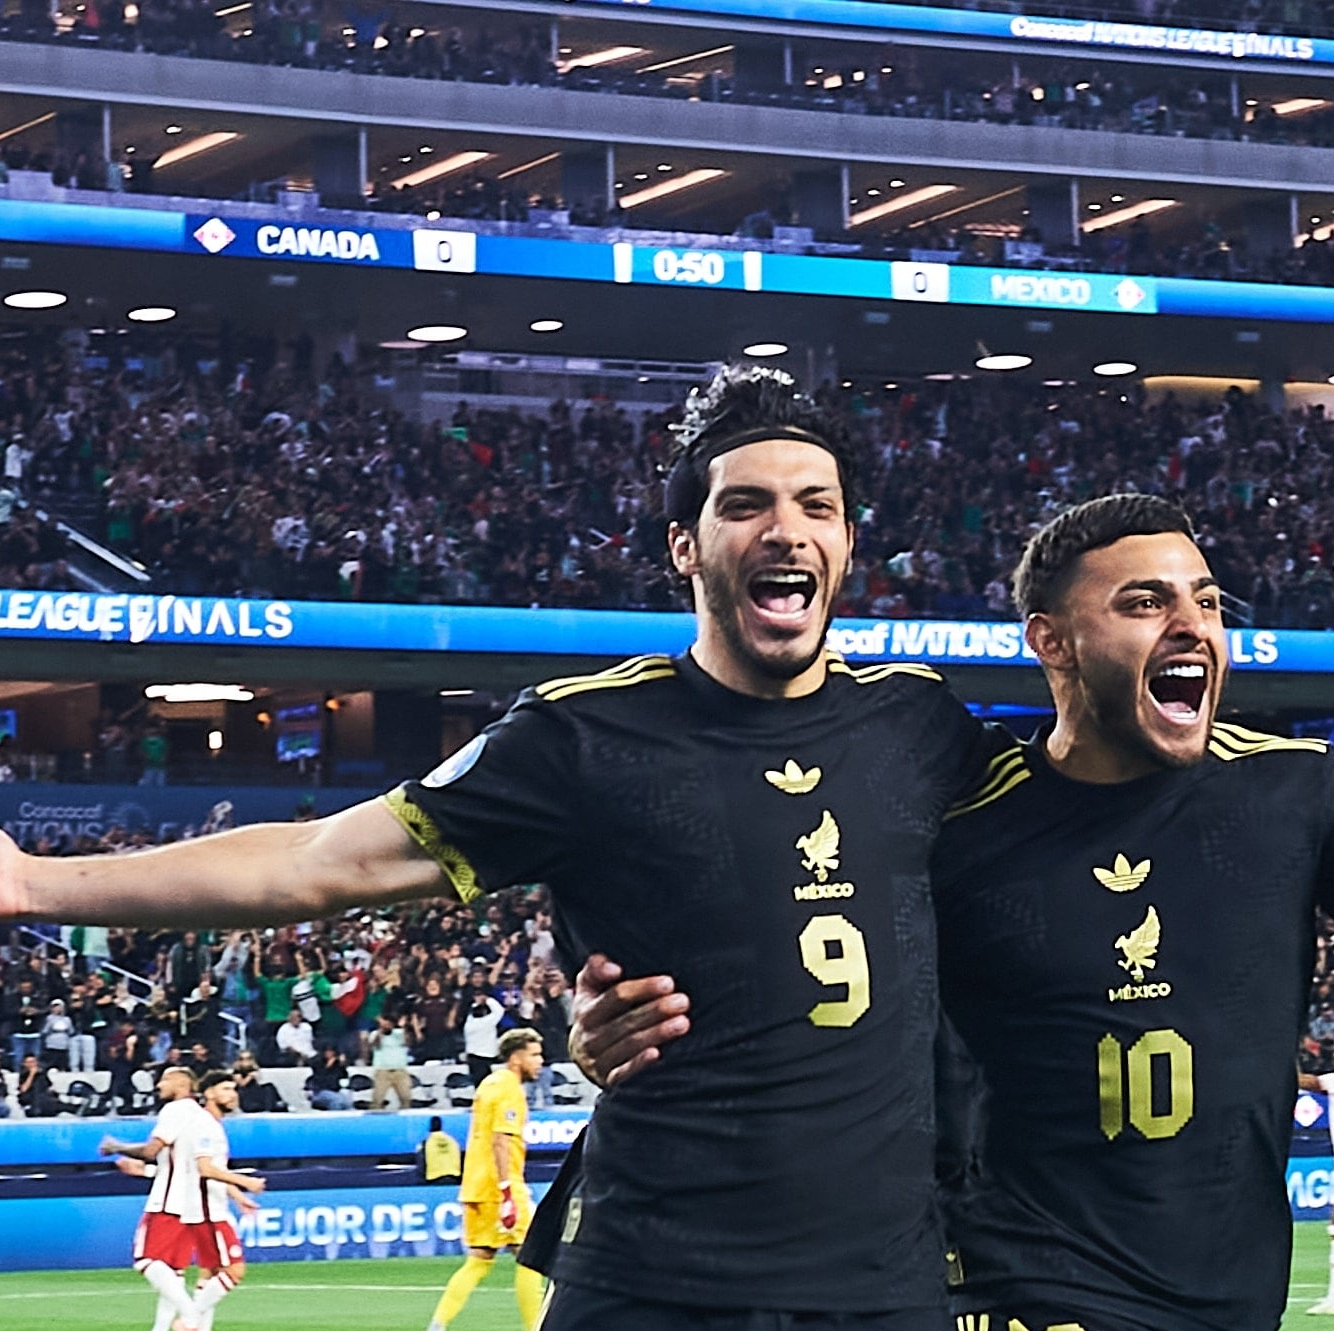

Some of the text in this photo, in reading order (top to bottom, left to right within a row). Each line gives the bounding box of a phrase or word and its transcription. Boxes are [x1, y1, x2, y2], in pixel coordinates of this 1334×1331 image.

[257, 225, 1092, 306] CANADA 0 0:50 0 MEXICO
[890, 622, 1021, 658] NATIONS
[798, 914, 871, 1028] 9
[1097, 1028, 1194, 1141] 10
[371, 1202, 429, 1243] DE
